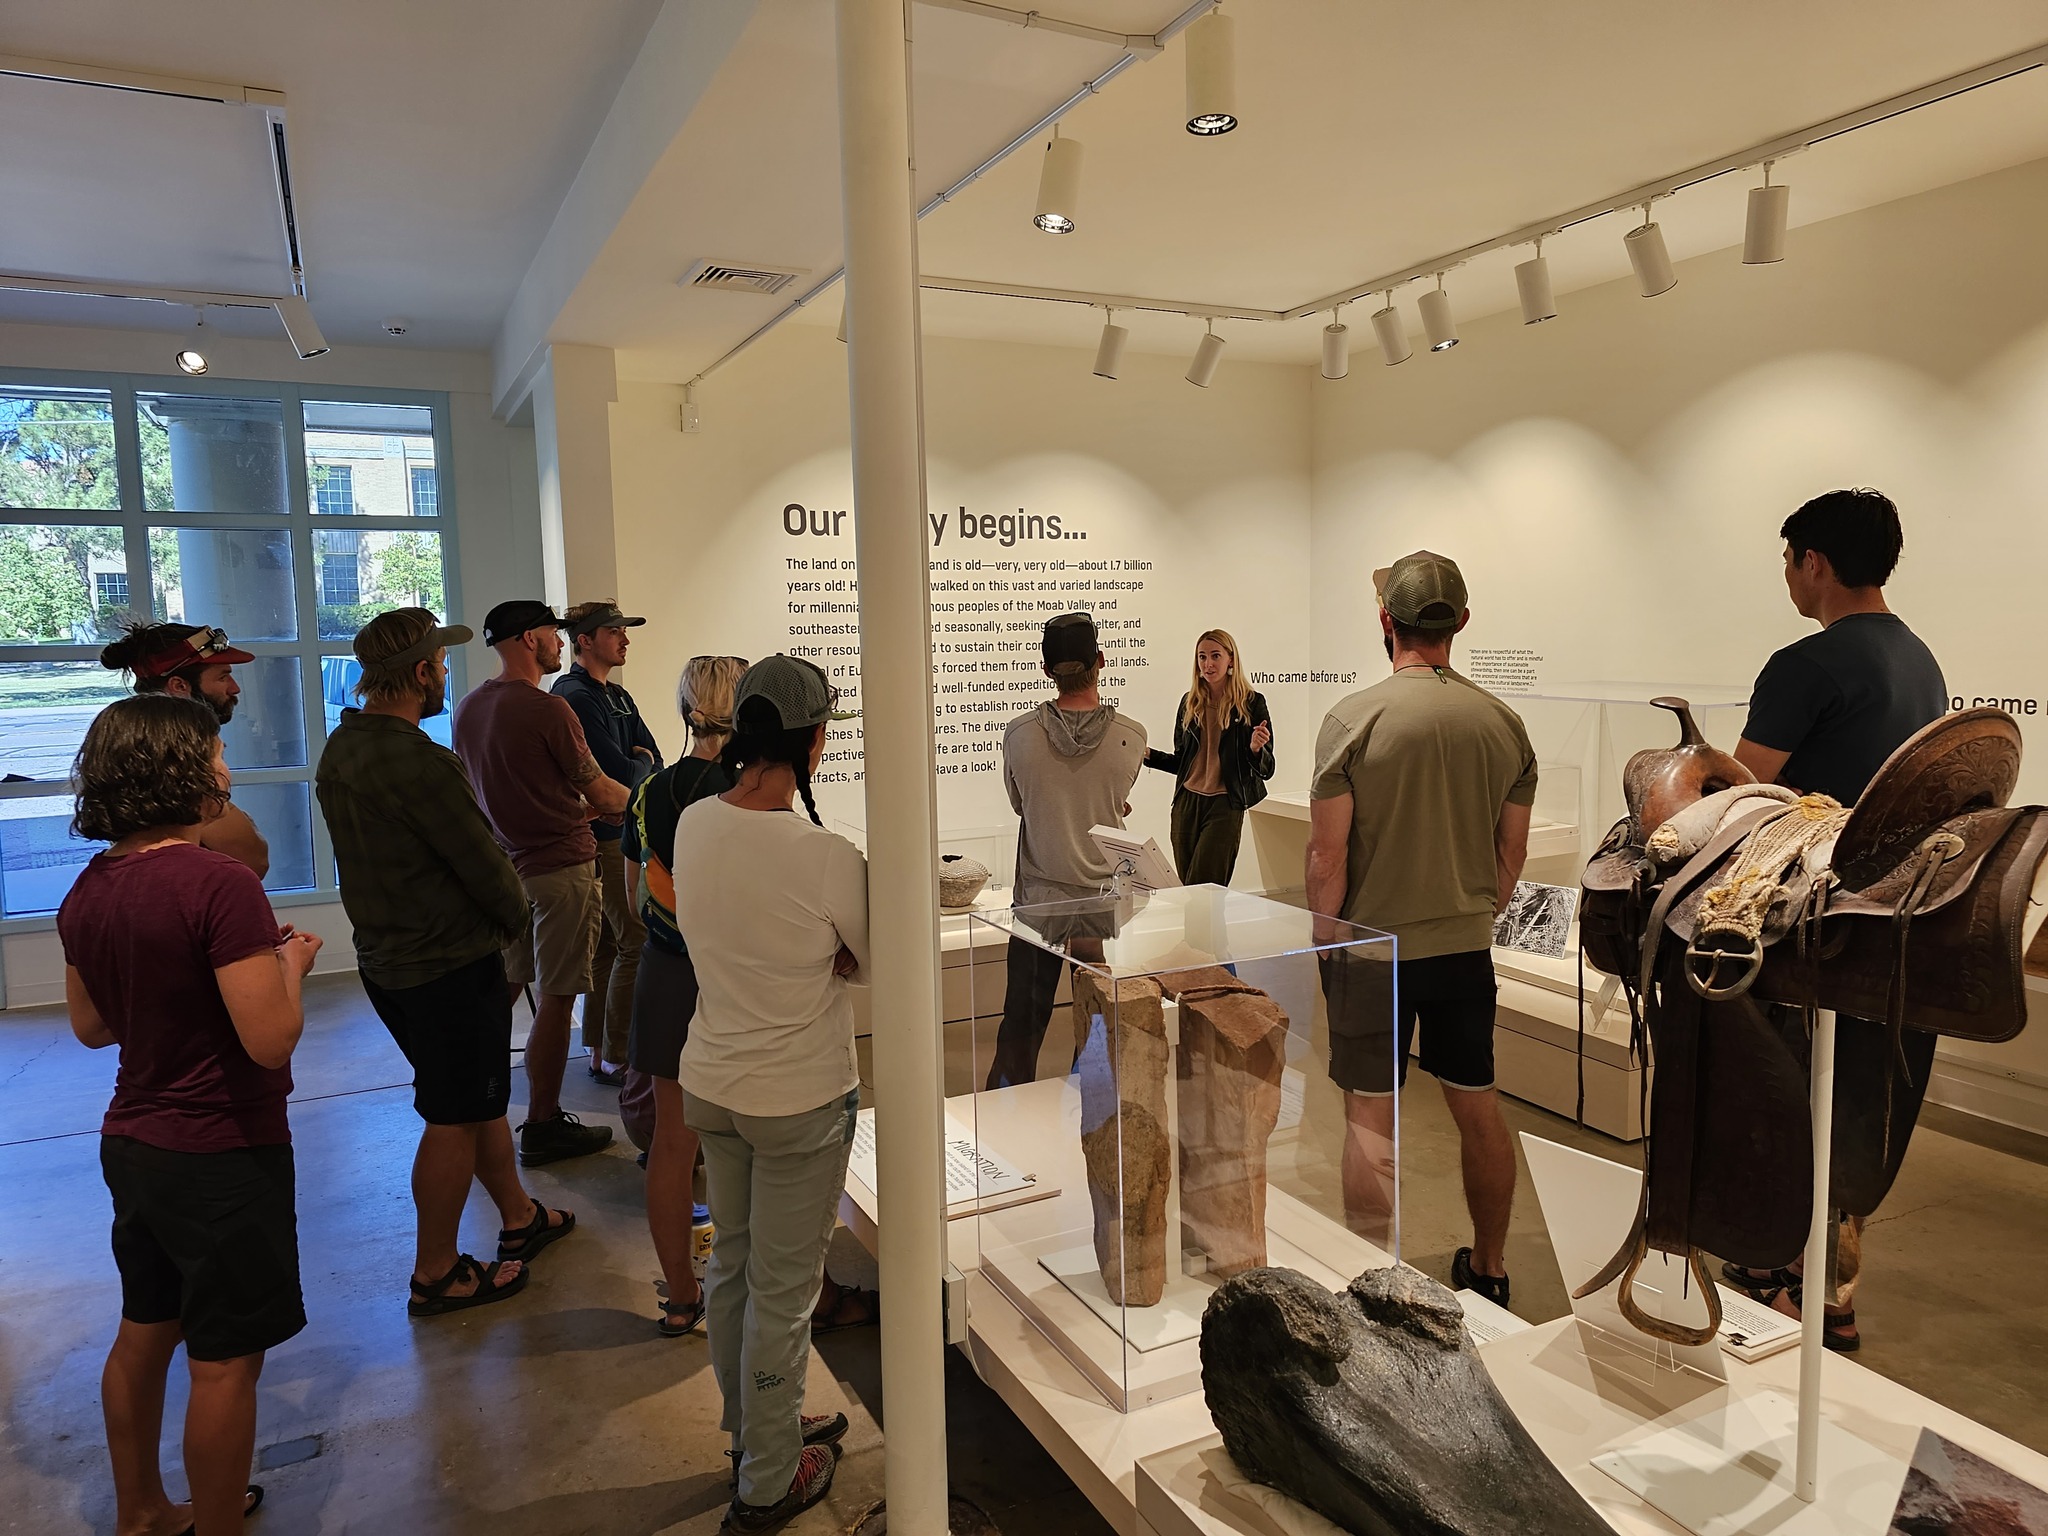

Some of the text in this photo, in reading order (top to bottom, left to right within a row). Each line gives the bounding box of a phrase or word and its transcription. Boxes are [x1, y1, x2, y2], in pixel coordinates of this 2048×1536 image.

[782, 503, 847, 536] Our
[959, 507, 1087, 547] begins...
[786, 558, 808, 570] The
[812, 558, 837, 570] land
[842, 560, 855, 570] on
[929, 560, 949, 570] and
[953, 560, 962, 570] is
[1024, 562, 1047, 573] very
[1124, 560, 1152, 570] billion
[787, 581, 820, 594] years
[825, 580, 846, 591] old!
[930, 580, 969, 591] walked
[972, 582, 985, 591] on
[989, 580, 1009, 591] this
[1012, 580, 1034, 591] vast
[1038, 580, 1056, 590] and
[1060, 580, 1090, 590] varied
[1094, 580, 1144, 592] landscape
[788, 602, 805, 613] for
[958, 601, 999, 614] peoples
[1002, 600, 1014, 611] of
[1016, 601, 1034, 611] the
[1037, 600, 1064, 611] Moab
[1067, 600, 1096, 611] Valley
[1099, 599, 1117, 610] and
[945, 621, 1003, 634] seasonally,
[1006, 620, 1046, 632] seeking
[1096, 619, 1121, 630] elter,
[1123, 618, 1141, 628] and
[790, 646, 822, 656] other
[827, 646, 860, 656] resou
[940, 643, 951, 653] to
[955, 642, 994, 653] sustain
[997, 641, 1022, 651] their
[1129, 638, 1146, 647] the
[833, 665, 845, 676] of
[942, 661, 977, 673] forced
[981, 661, 1008, 672] them
[1012, 660, 1036, 671] from
[1121, 656, 1149, 667] lands.
[942, 681, 1005, 693] well-funded
[1008, 679, 1056, 692] expeditio
[1110, 677, 1126, 686] the
[1250, 670, 1356, 683] Who came before us?
[946, 704, 956, 713] to
[960, 701, 1008, 713] establish
[825, 730, 853, 740] shes
[962, 722, 981, 732] The
[984, 721, 1008, 731] dive
[821, 749, 864, 764] pective
[952, 744, 969, 753] are
[972, 741, 992, 752] told
[814, 772, 851, 783] ifacts,
[962, 764, 968, 772] a
[971, 761, 996, 772] look!
[948, 1140, 1010, 1179] MIGRATION
